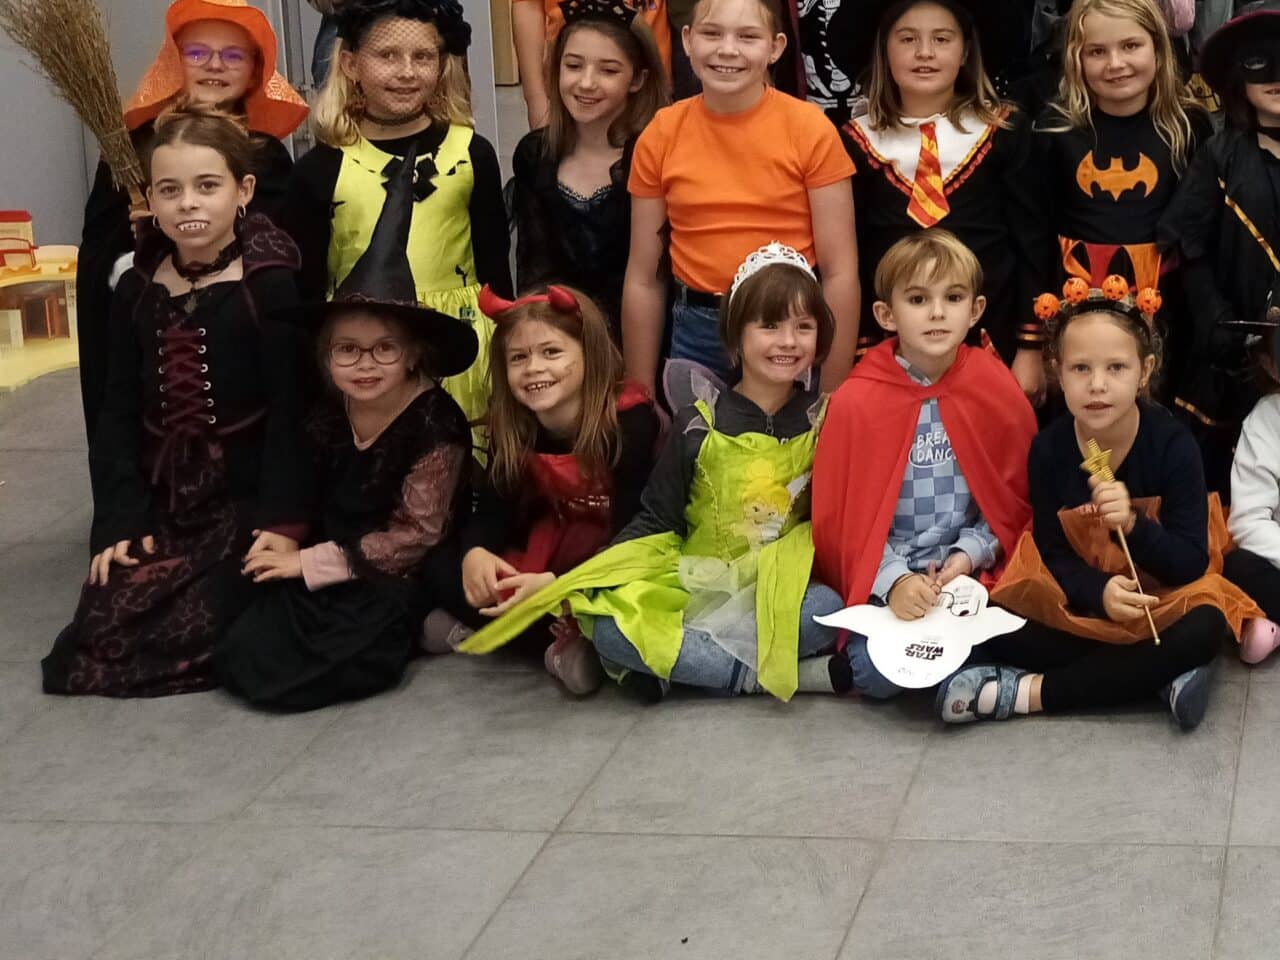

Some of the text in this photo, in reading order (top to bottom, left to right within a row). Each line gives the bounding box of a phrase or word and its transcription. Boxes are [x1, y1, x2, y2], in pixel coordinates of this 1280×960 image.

[917, 447, 957, 463] DANC
[905, 643, 944, 655] WARS
[905, 648, 943, 660] STAR
